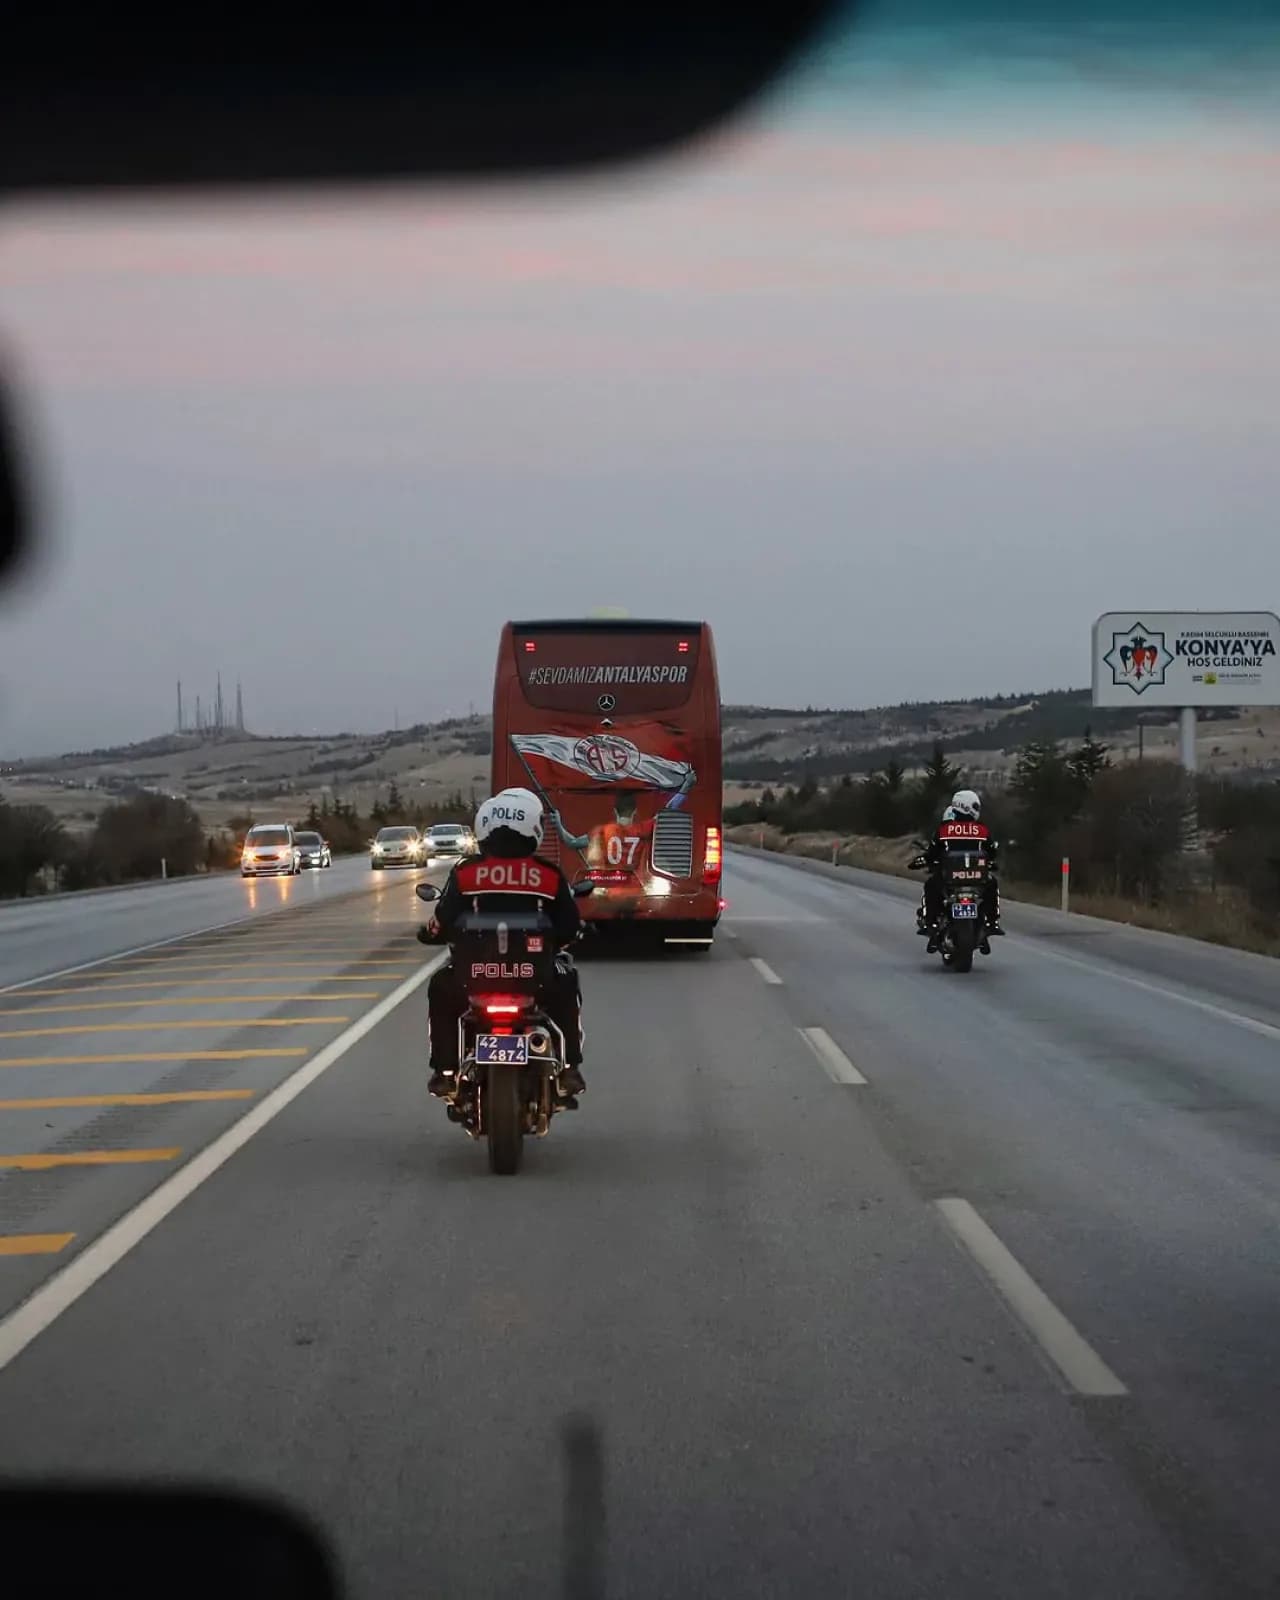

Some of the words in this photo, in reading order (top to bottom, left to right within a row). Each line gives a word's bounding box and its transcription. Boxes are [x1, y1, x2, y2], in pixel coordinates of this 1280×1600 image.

[1175, 639, 1276, 656] KONYA'YA
[1187, 657, 1211, 667] HOŞ
[948, 823, 980, 835] POLİS
[607, 836, 640, 865] 07
[475, 863, 542, 887] POLİS
[479, 1036, 498, 1048] 42
[516, 1037, 525, 1048] A
[488, 1050, 526, 1062] 4874
